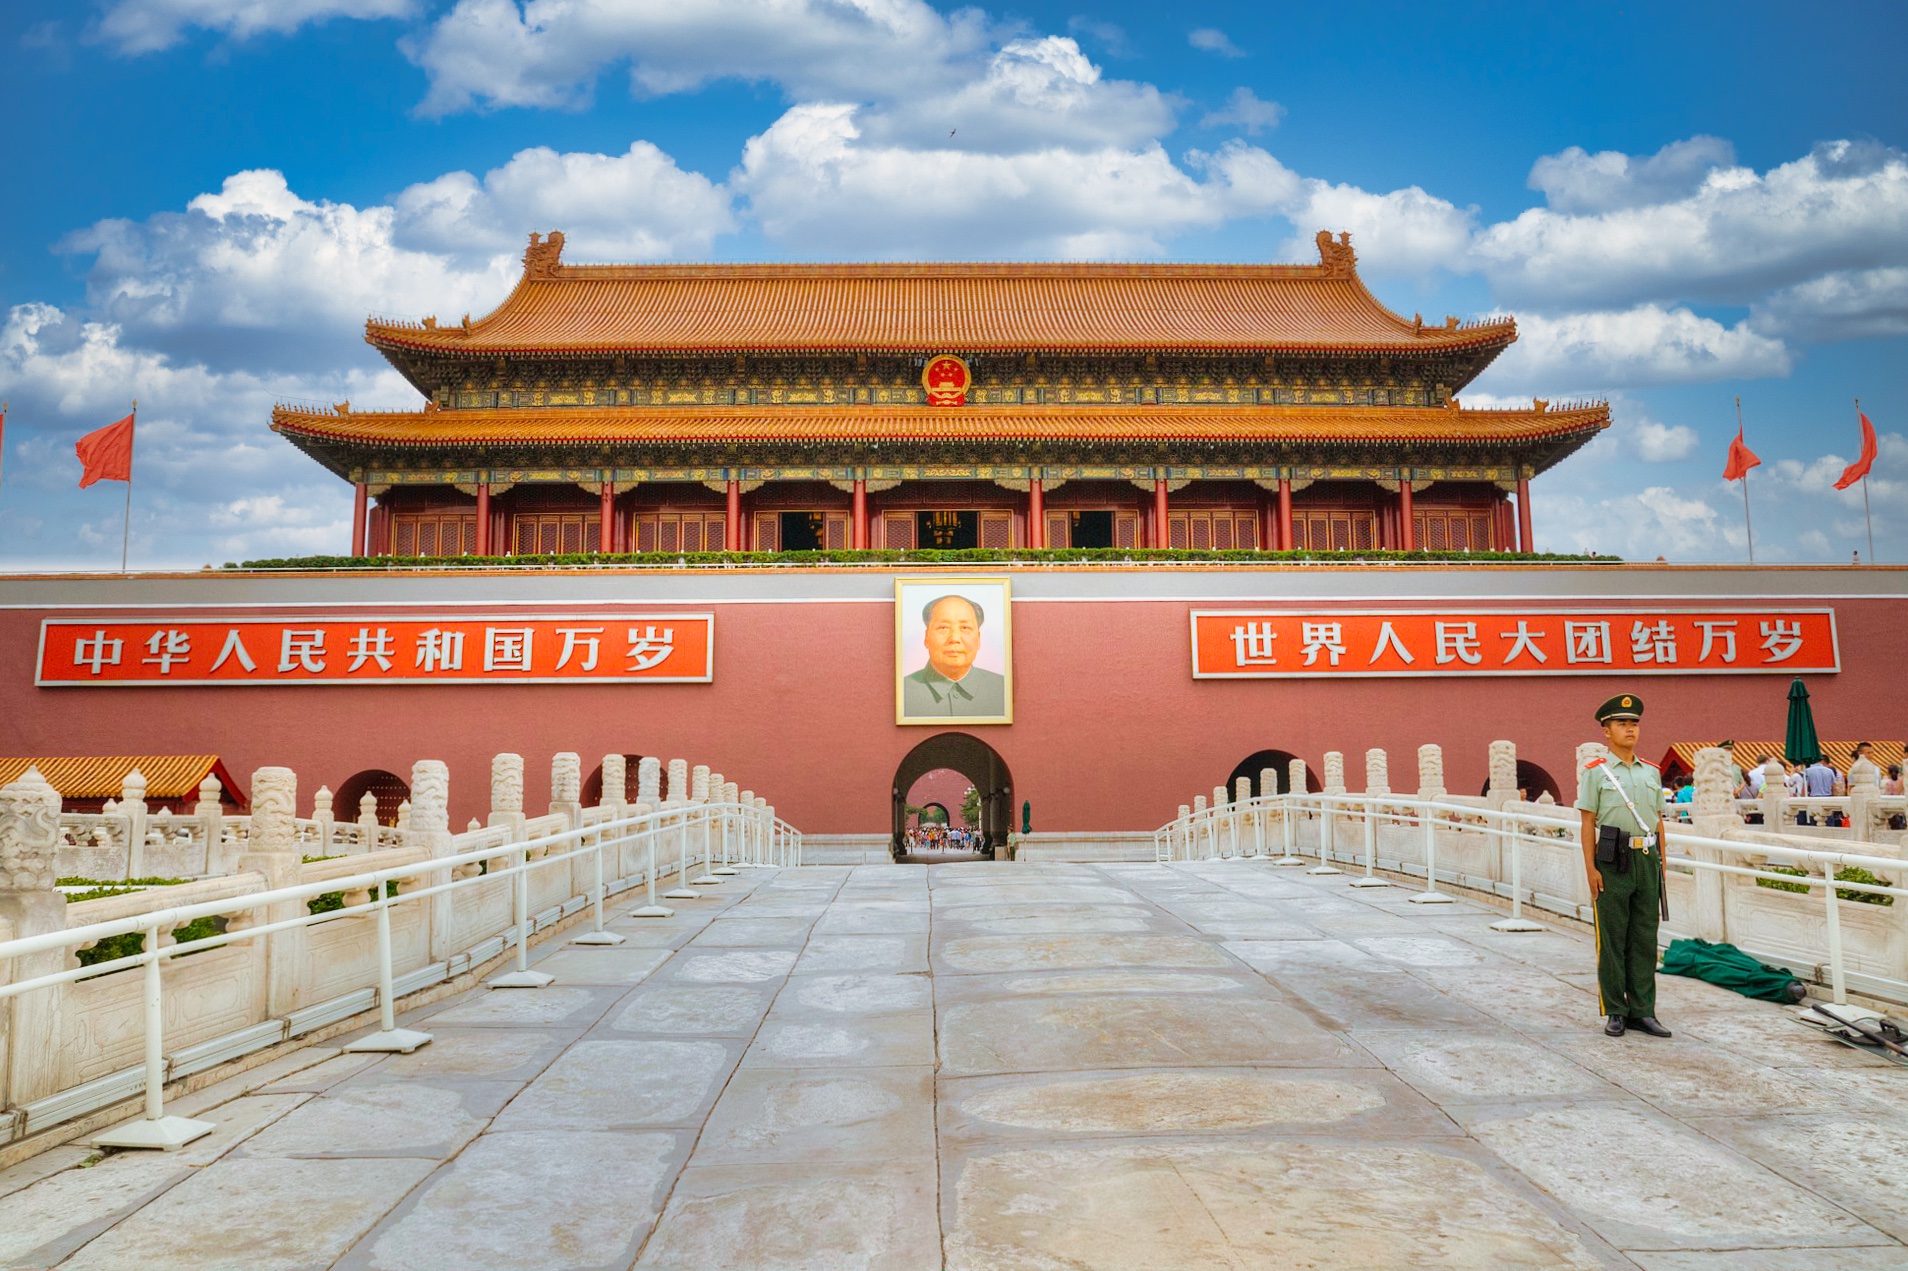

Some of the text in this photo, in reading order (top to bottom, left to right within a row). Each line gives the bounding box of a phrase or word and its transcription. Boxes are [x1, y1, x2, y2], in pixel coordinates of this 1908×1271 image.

[73, 626, 675, 674] 中华人民共和国万岁
[1229, 620, 1803, 667] 世界人民大团结万岁
